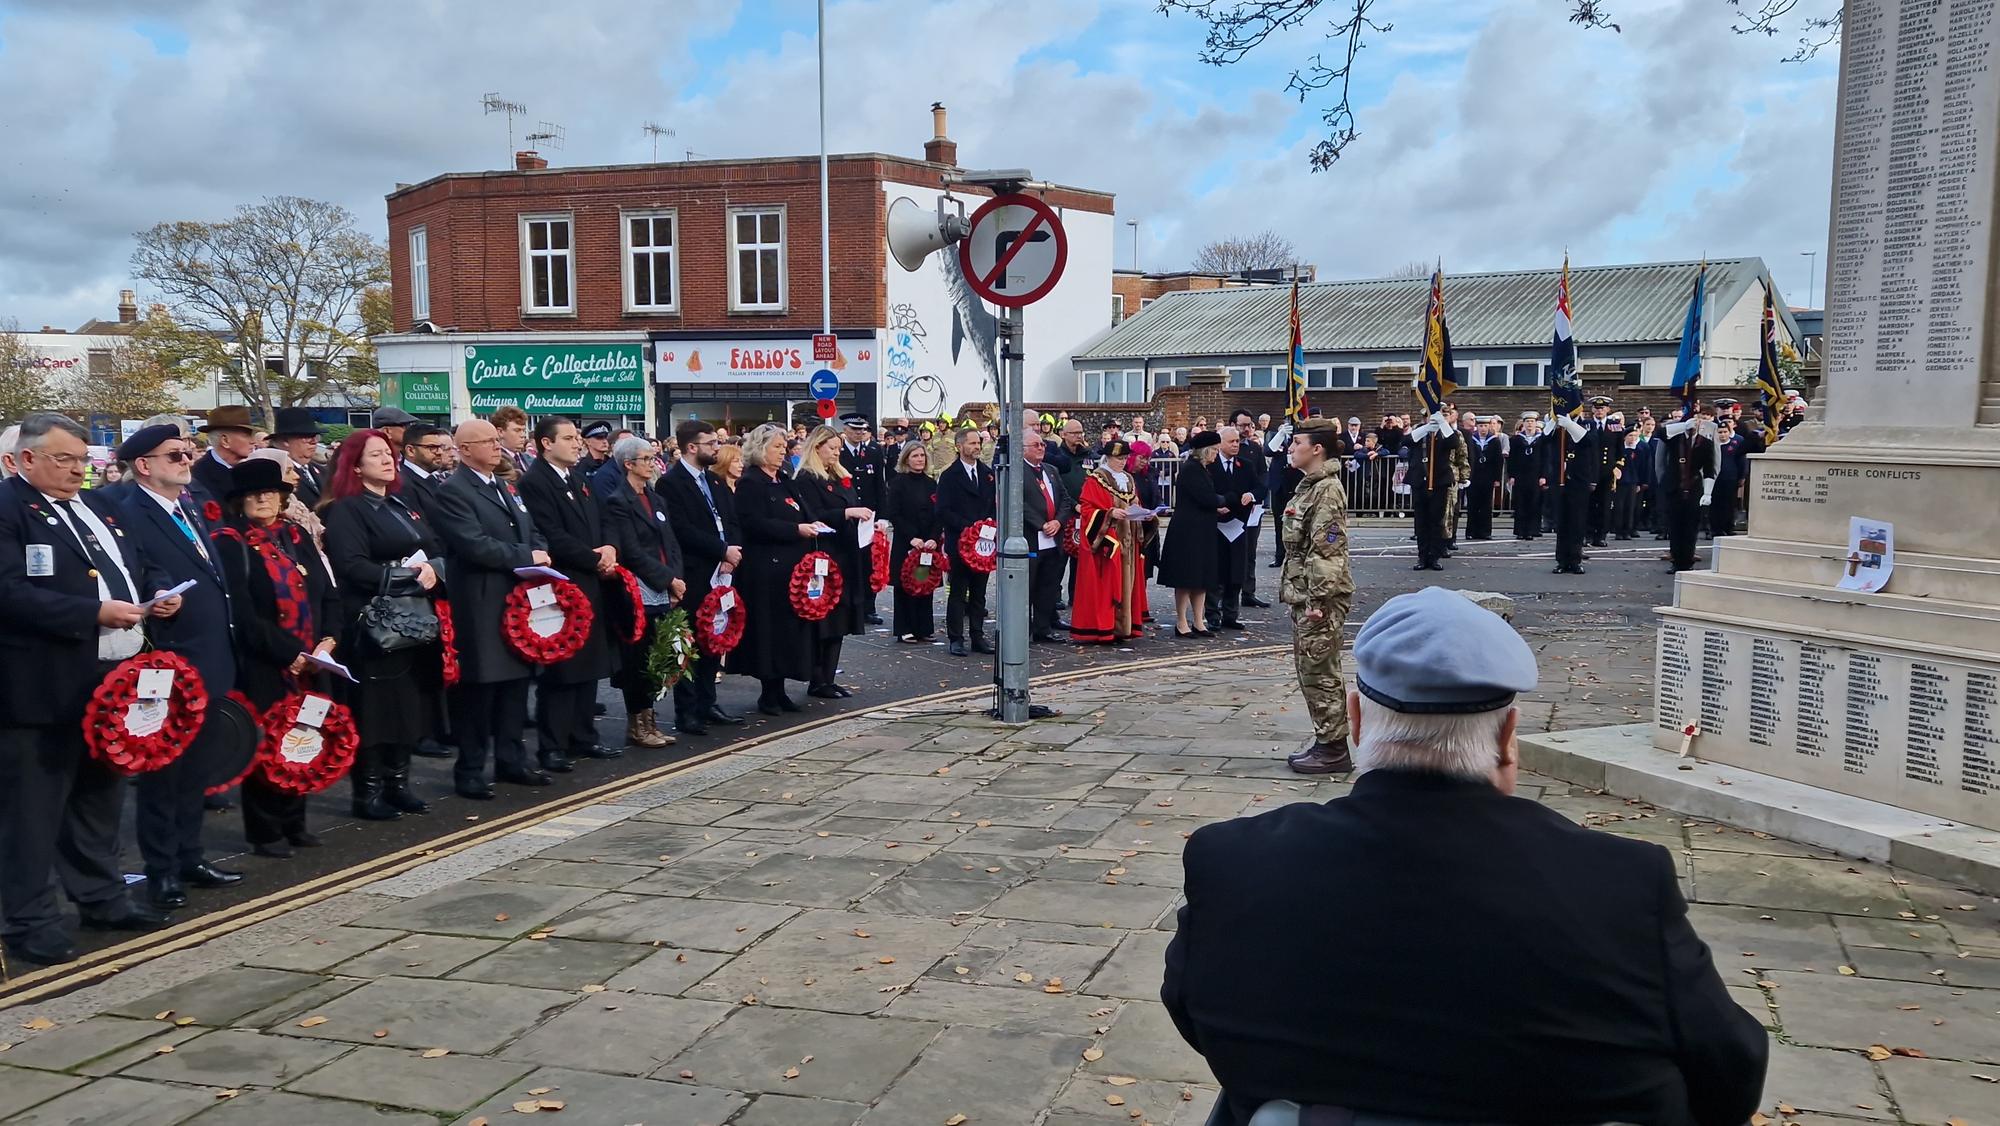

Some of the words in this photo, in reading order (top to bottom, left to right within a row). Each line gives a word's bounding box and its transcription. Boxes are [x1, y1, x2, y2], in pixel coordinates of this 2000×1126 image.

[663, 352, 674, 362] 80
[858, 350, 870, 360] 80
[472, 359, 517, 384] Coins
[523, 356, 537, 376] &
[542, 350, 637, 380] Collectables
[573, 374, 600, 387] Bought
[602, 374, 614, 382] and
[617, 371, 635, 382] Sold
[405, 392, 448, 400] COLLECTABLES
[472, 394, 518, 409] Antiques
[525, 394, 585, 410] Purchased
[1828, 468, 1859, 477] OTHER
[1866, 470, 1921, 480] CONFLICTS
